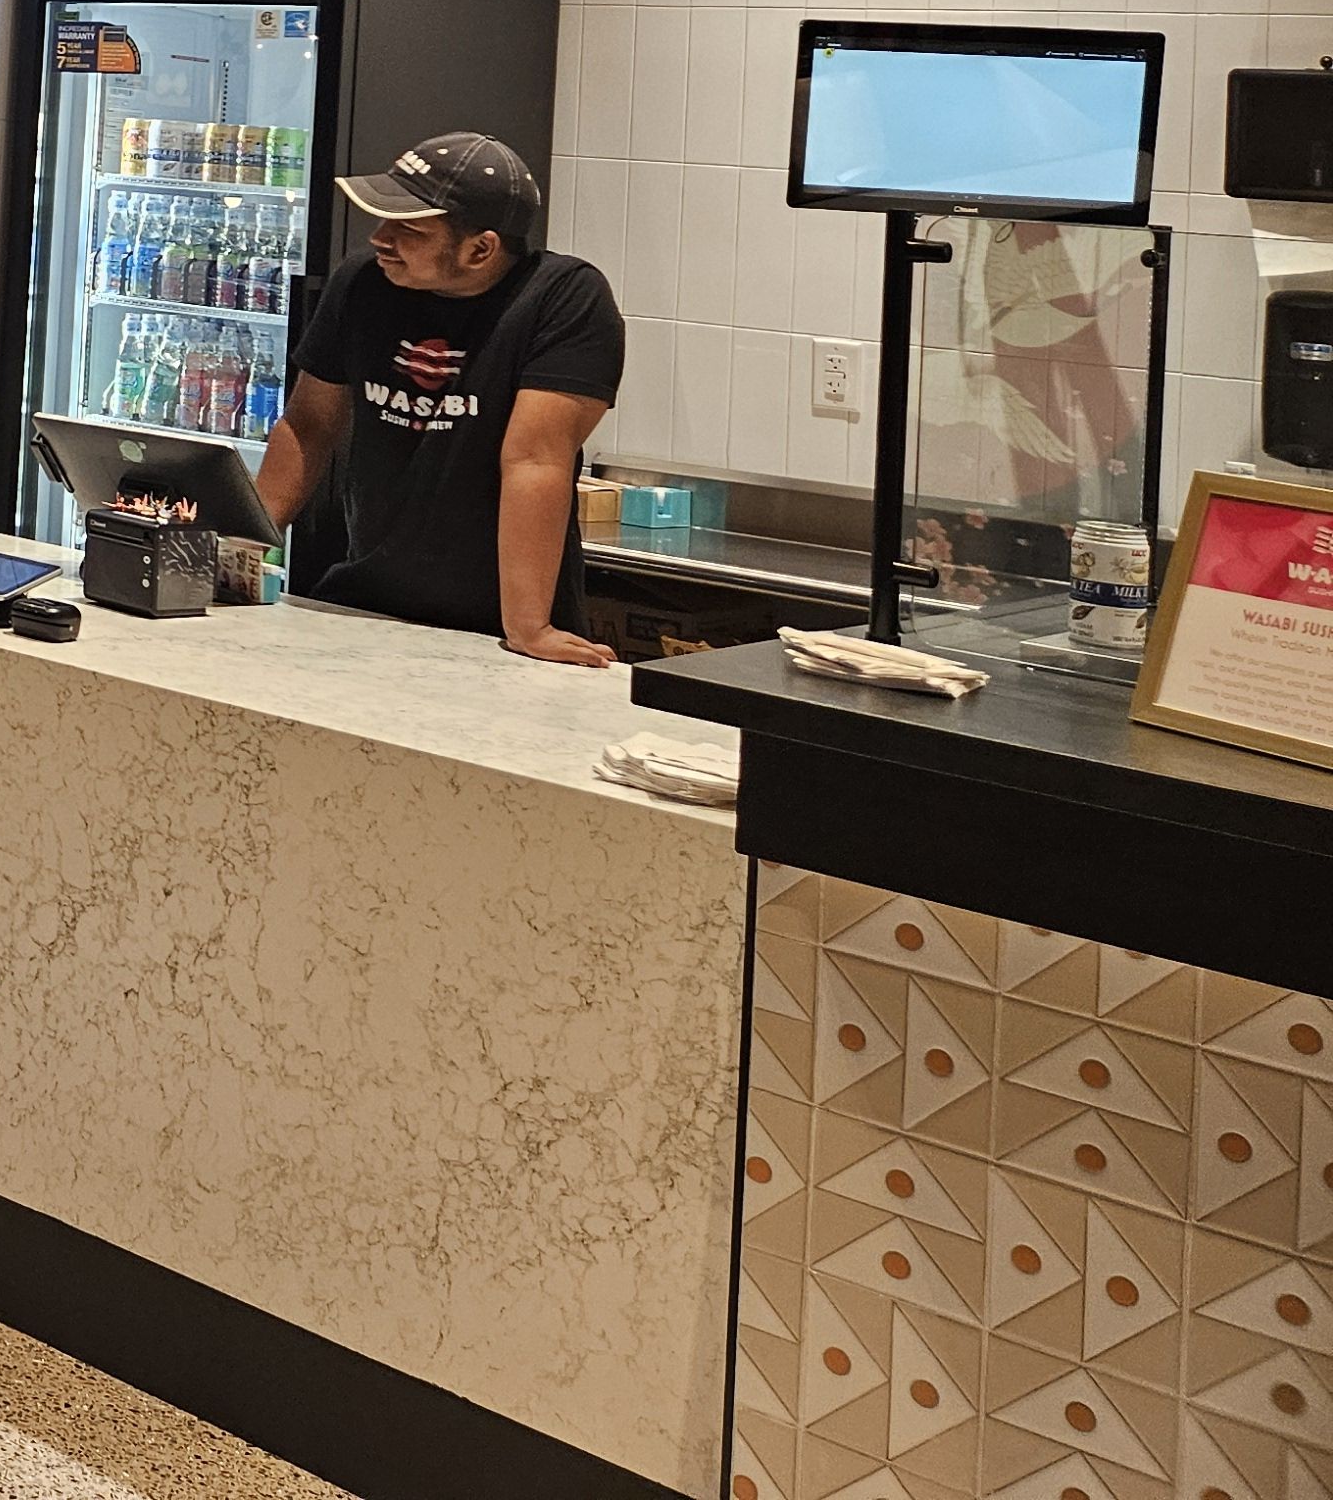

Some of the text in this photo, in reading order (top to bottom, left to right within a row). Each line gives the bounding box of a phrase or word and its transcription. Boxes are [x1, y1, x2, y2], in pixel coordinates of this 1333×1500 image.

[56, 42, 67, 54] 5
[56, 56, 67, 69] 7
[1079, 581, 1101, 594] TEA
[1114, 586, 1142, 598] MILK
[1243, 609, 1333, 640] WASABI SUSH
